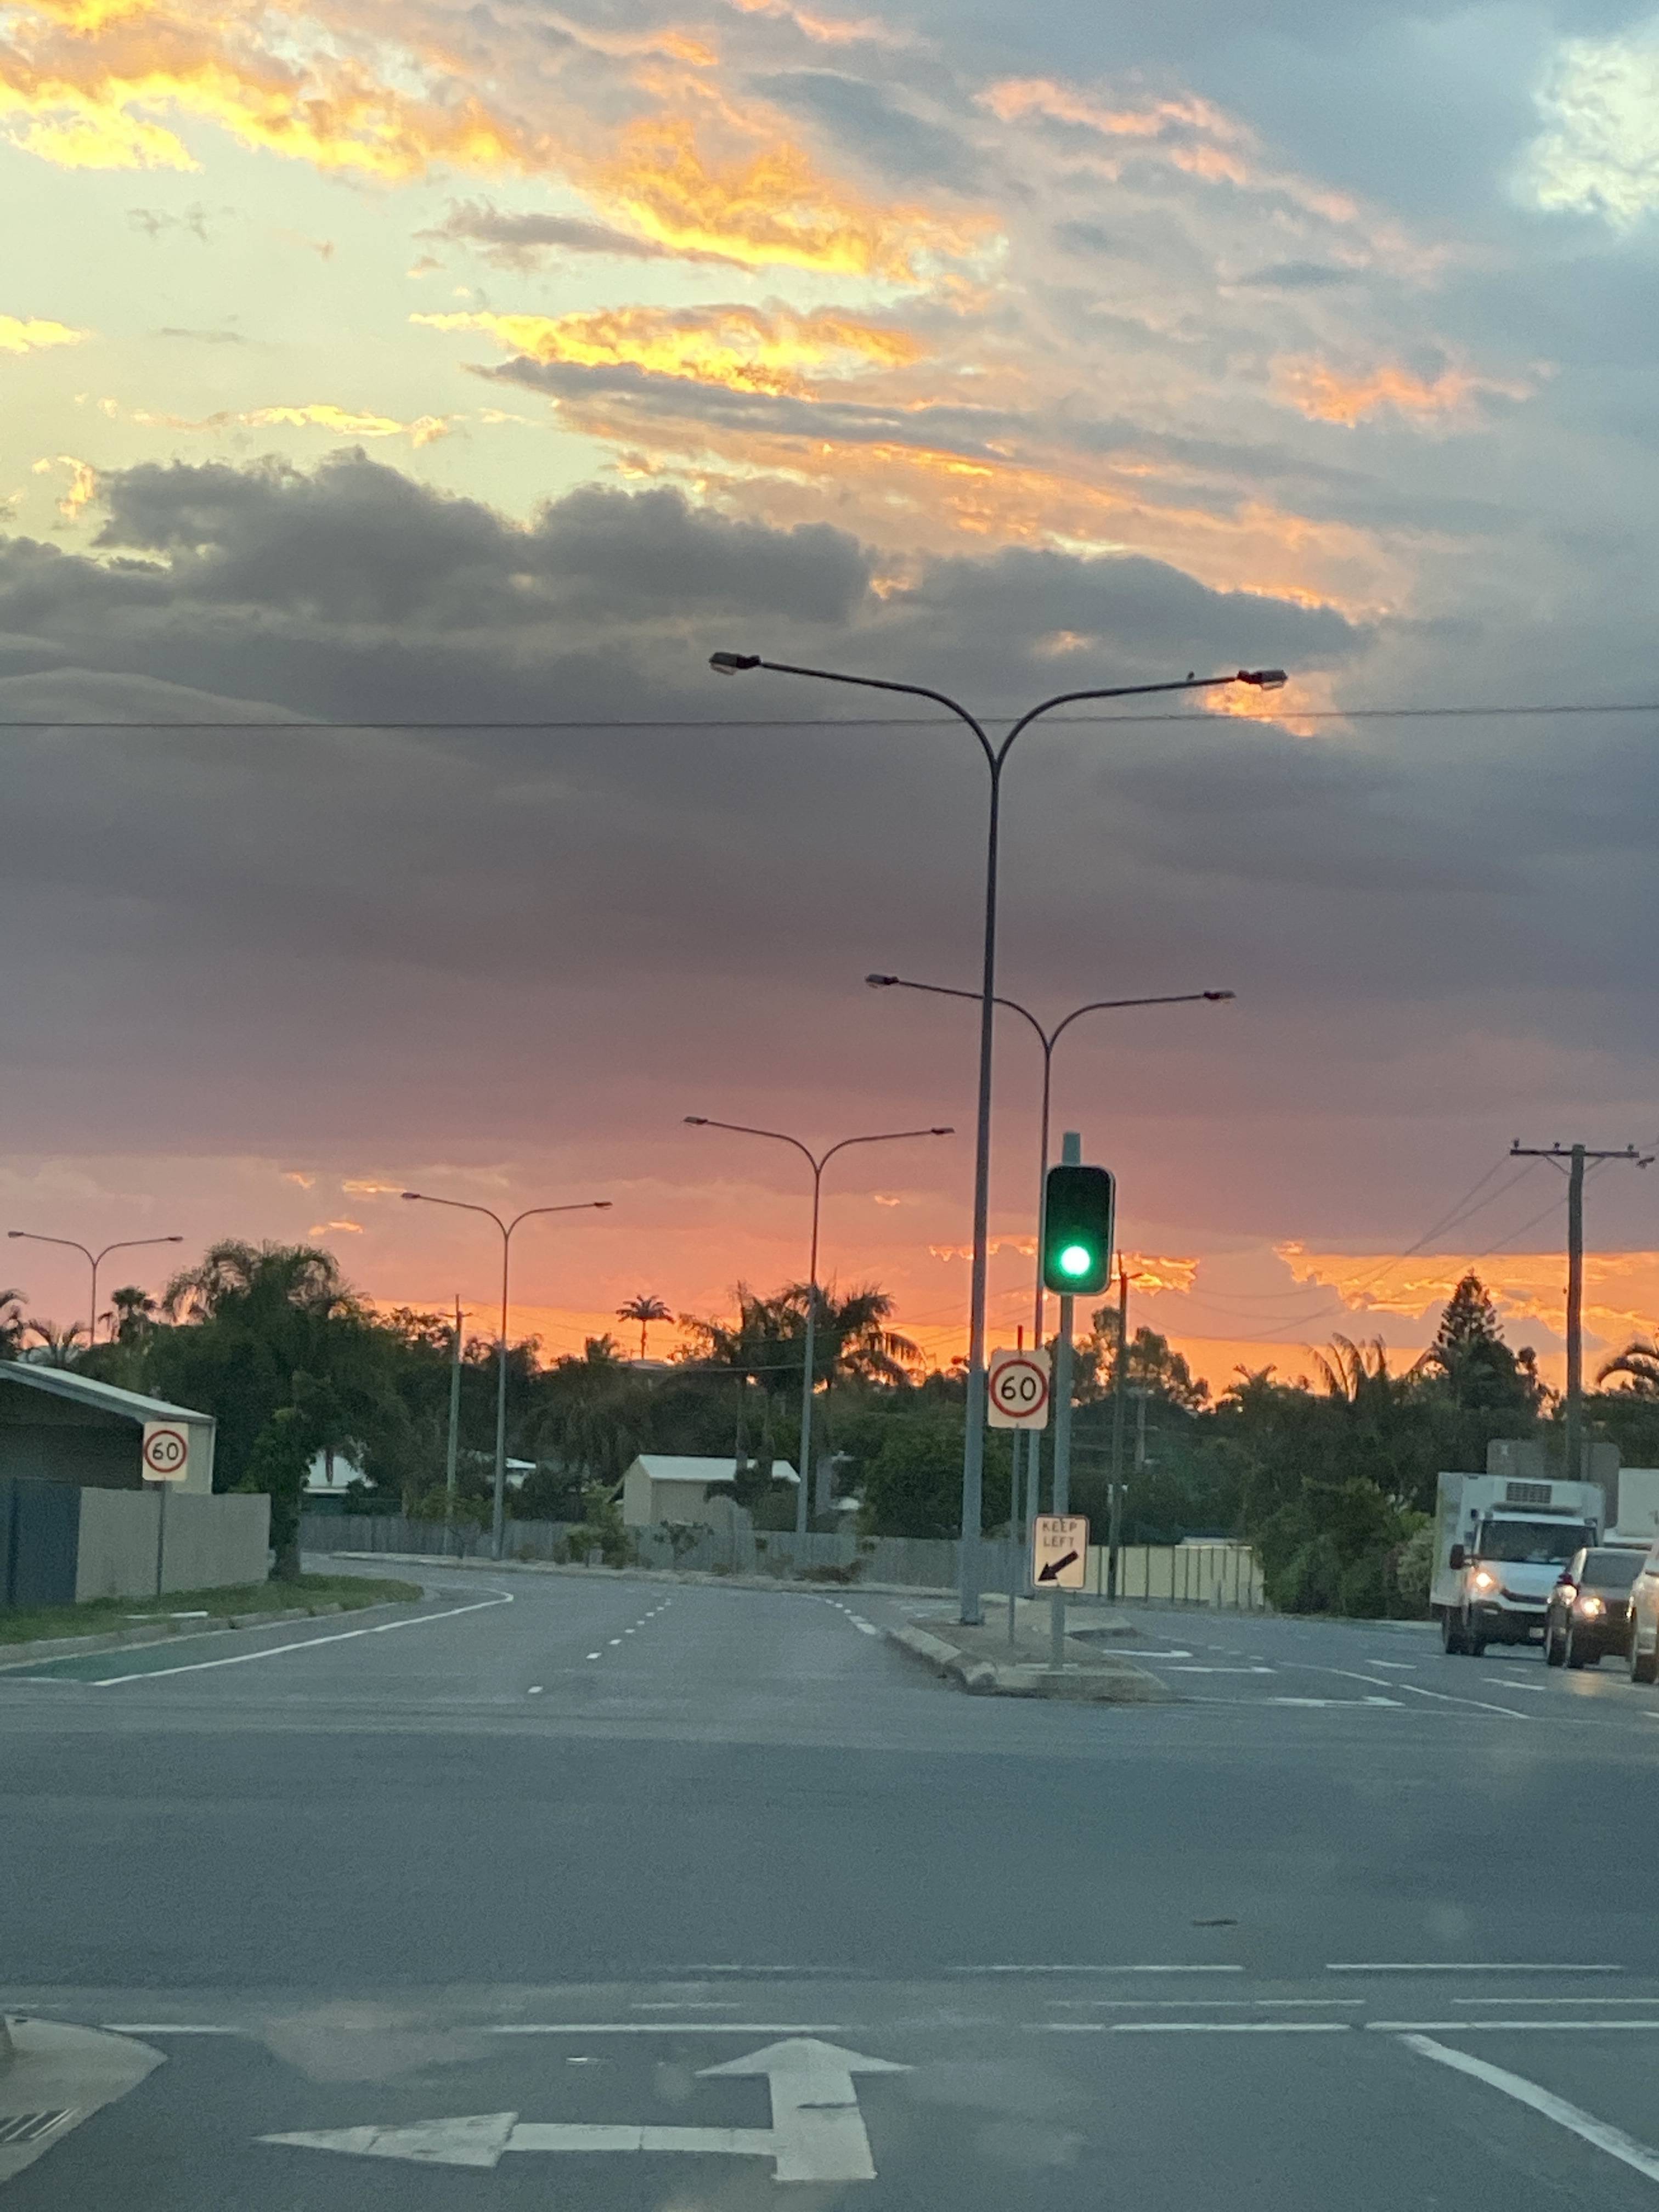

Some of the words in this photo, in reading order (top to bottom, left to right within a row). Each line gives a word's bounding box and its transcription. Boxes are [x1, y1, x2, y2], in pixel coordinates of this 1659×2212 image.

[1001, 1375, 1036, 1401] 60
[153, 1442, 179, 1460] 60
[1042, 1521, 1077, 1532] KEEP
[1043, 1536, 1074, 1547] LEFT
